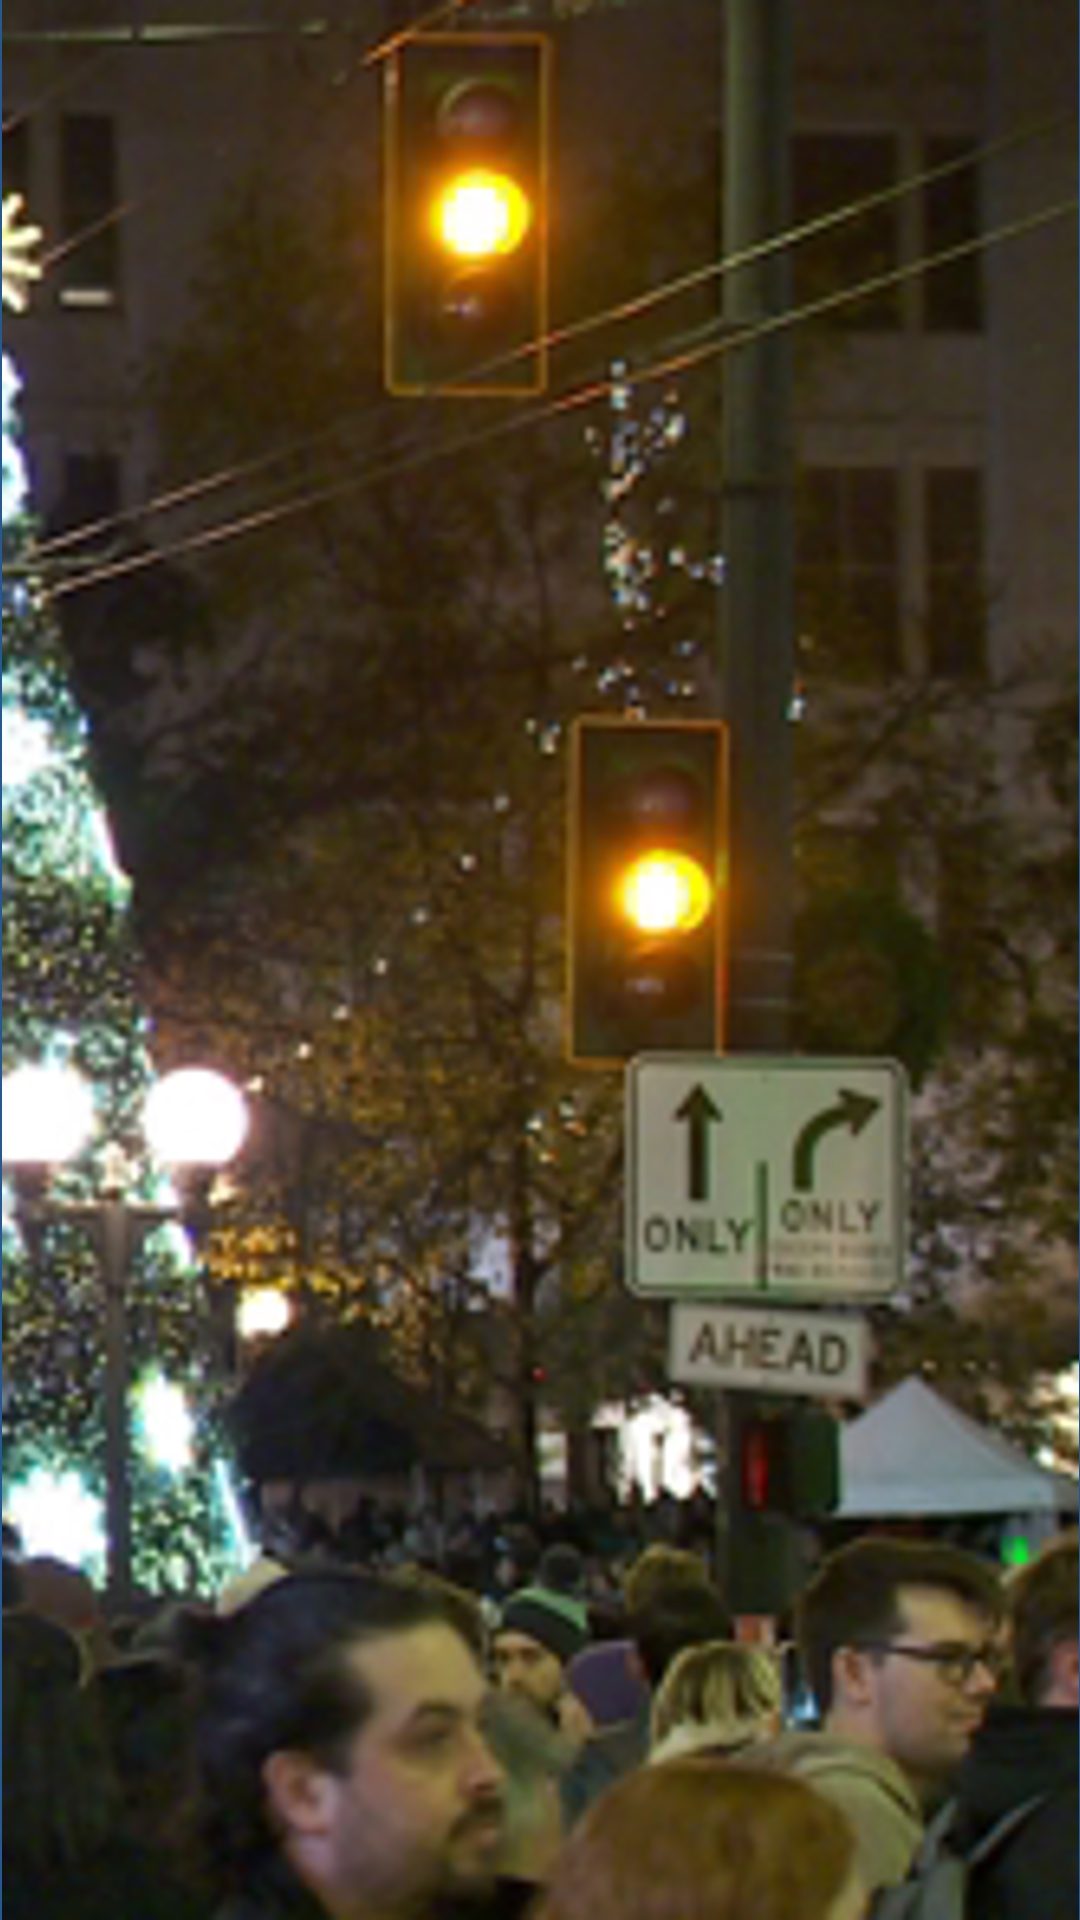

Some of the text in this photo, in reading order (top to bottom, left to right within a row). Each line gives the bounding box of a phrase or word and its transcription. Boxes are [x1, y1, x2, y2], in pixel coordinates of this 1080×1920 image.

[644, 1216, 752, 1254] ONLY
[780, 1199, 880, 1233] ONLY
[689, 1322, 848, 1376] AHEAD
